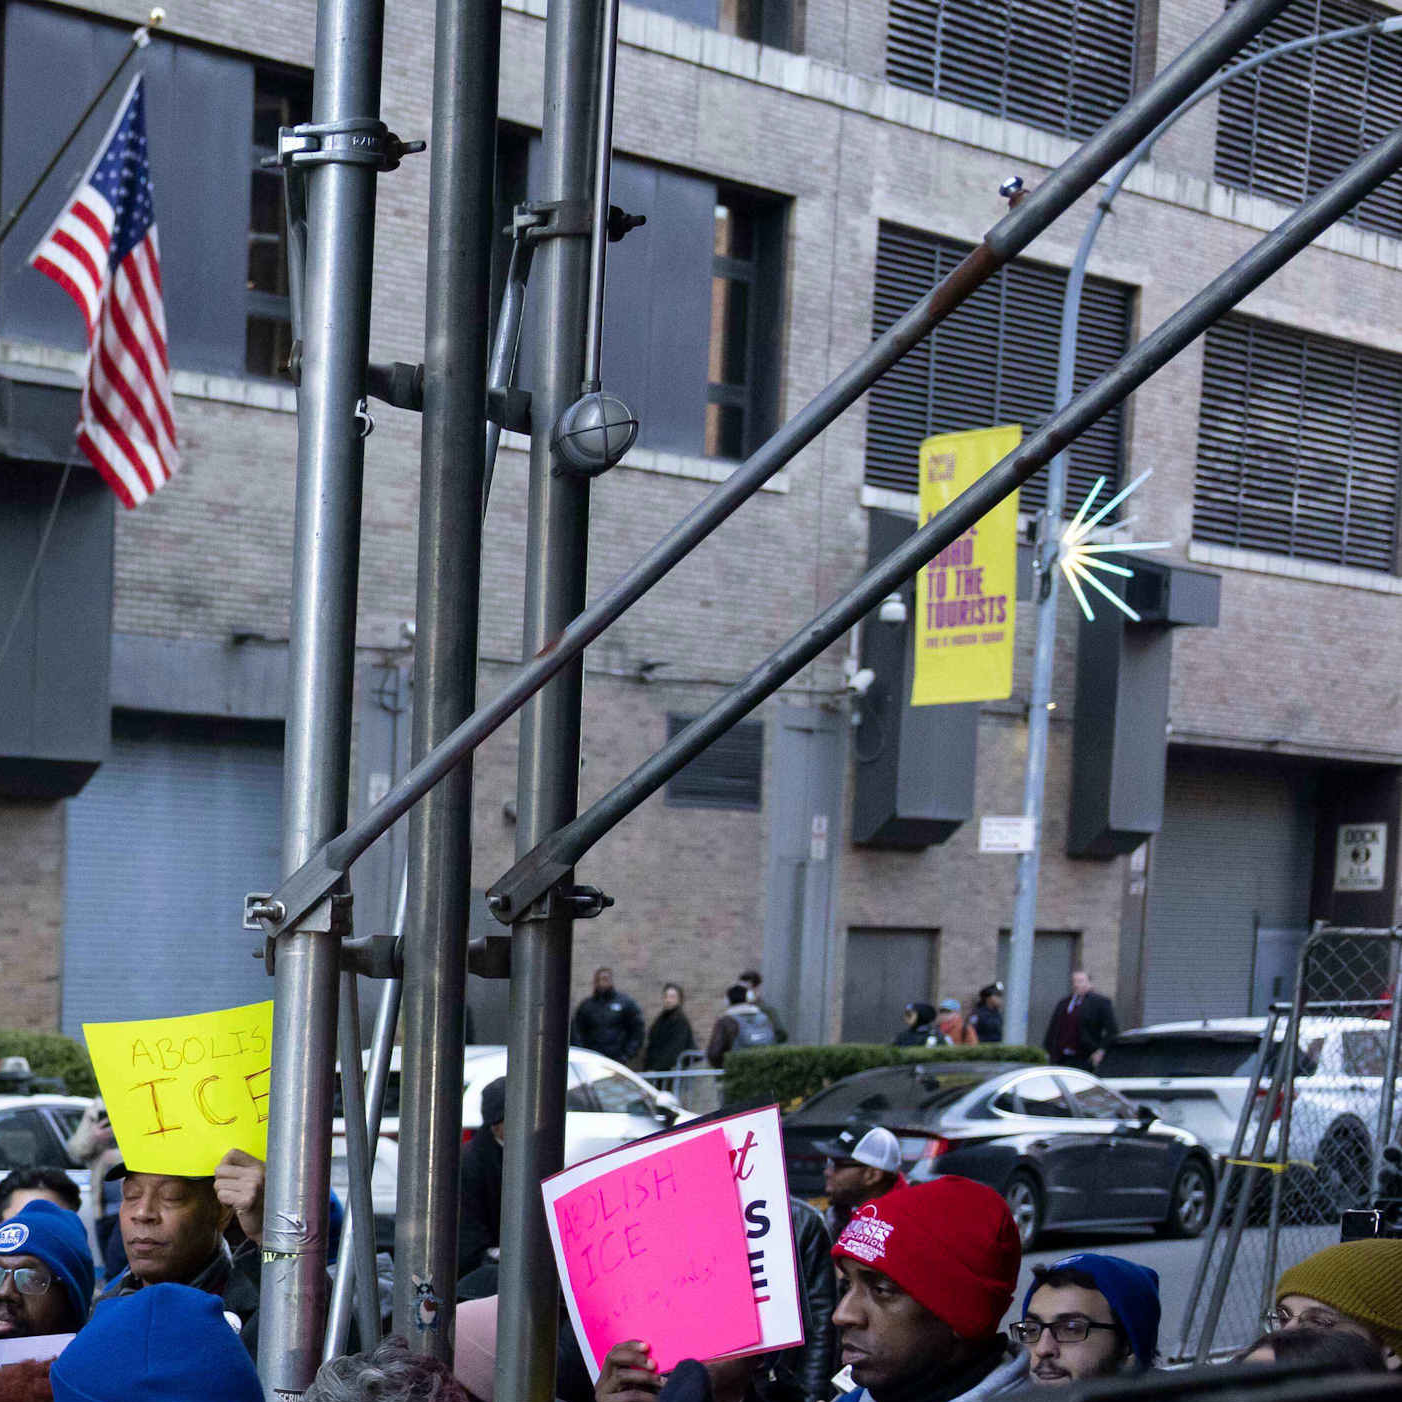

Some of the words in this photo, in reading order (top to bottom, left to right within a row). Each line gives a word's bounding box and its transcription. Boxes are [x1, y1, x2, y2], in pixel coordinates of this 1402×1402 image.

[927, 571, 947, 600] TO
[956, 567, 984, 596] THE
[926, 595, 1007, 630] TOURISTS
[132, 1025, 267, 1071] ABOLIS
[127, 1067, 272, 1138] ICE
[581, 1221, 648, 1289] ICE
